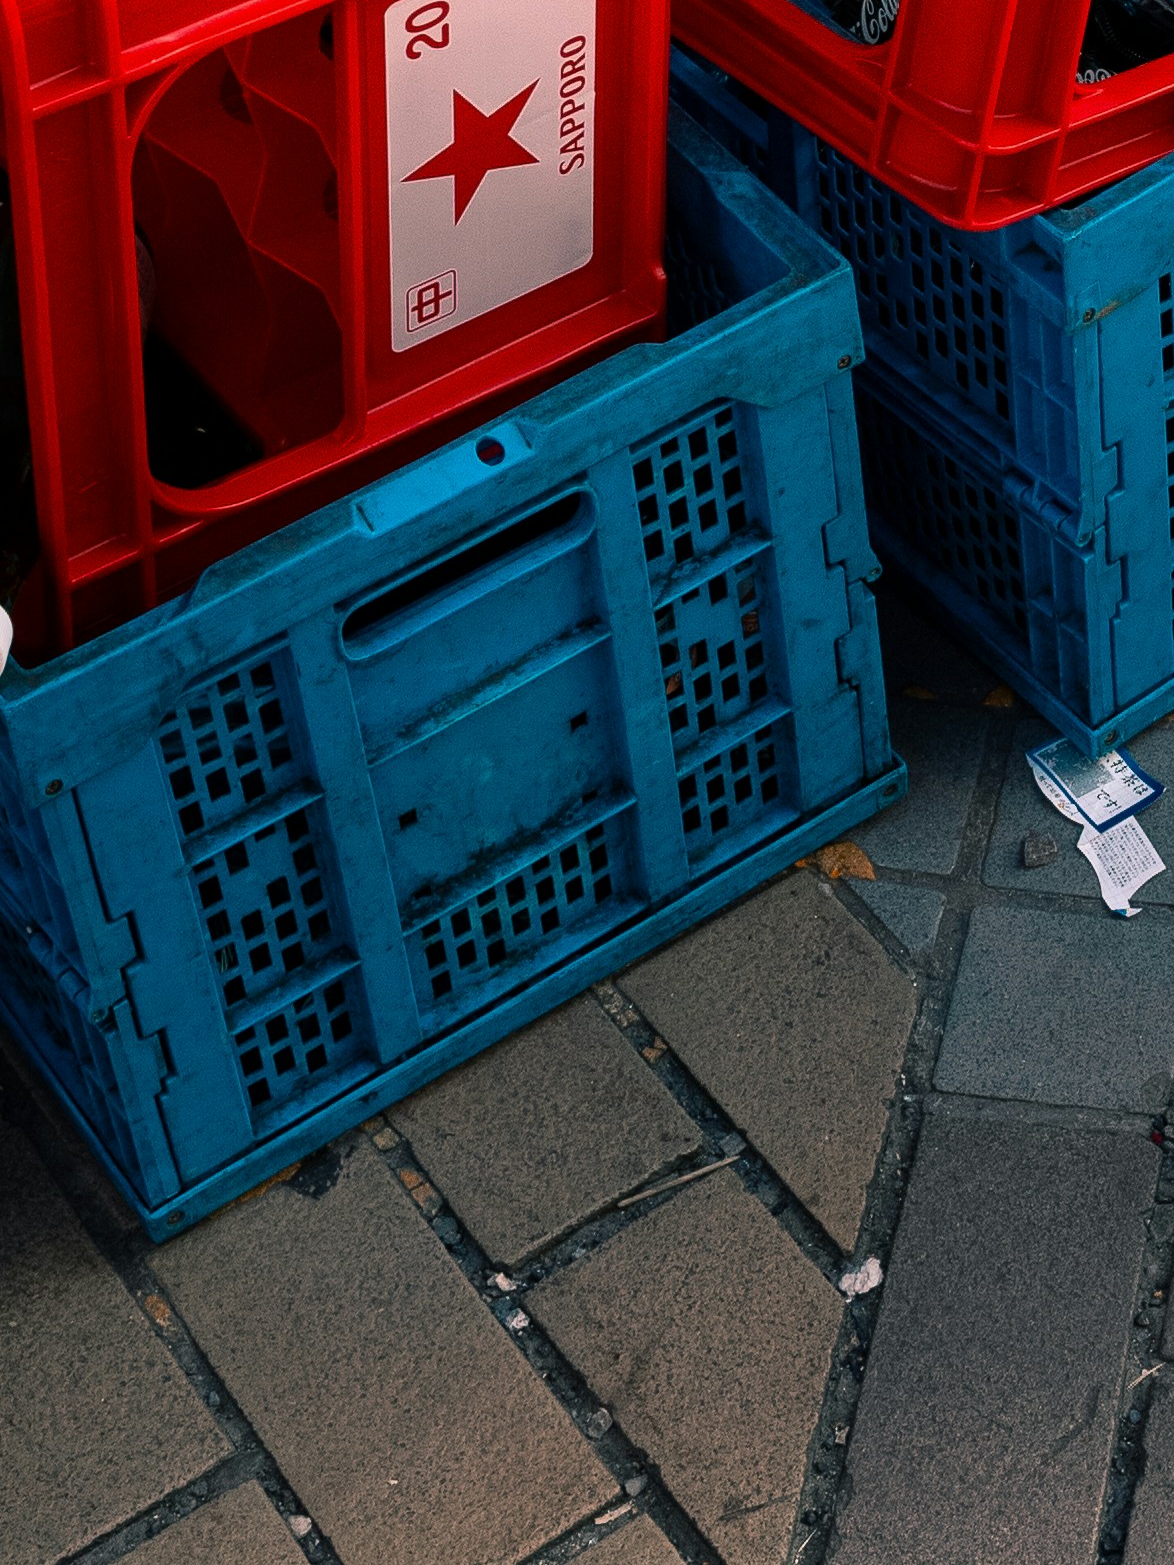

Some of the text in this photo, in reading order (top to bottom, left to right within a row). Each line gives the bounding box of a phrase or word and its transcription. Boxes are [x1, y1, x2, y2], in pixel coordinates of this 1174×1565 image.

[405, 0, 451, 60] 20
[559, 35, 587, 176] SAPPORO
[409, 278, 454, 326] 中
